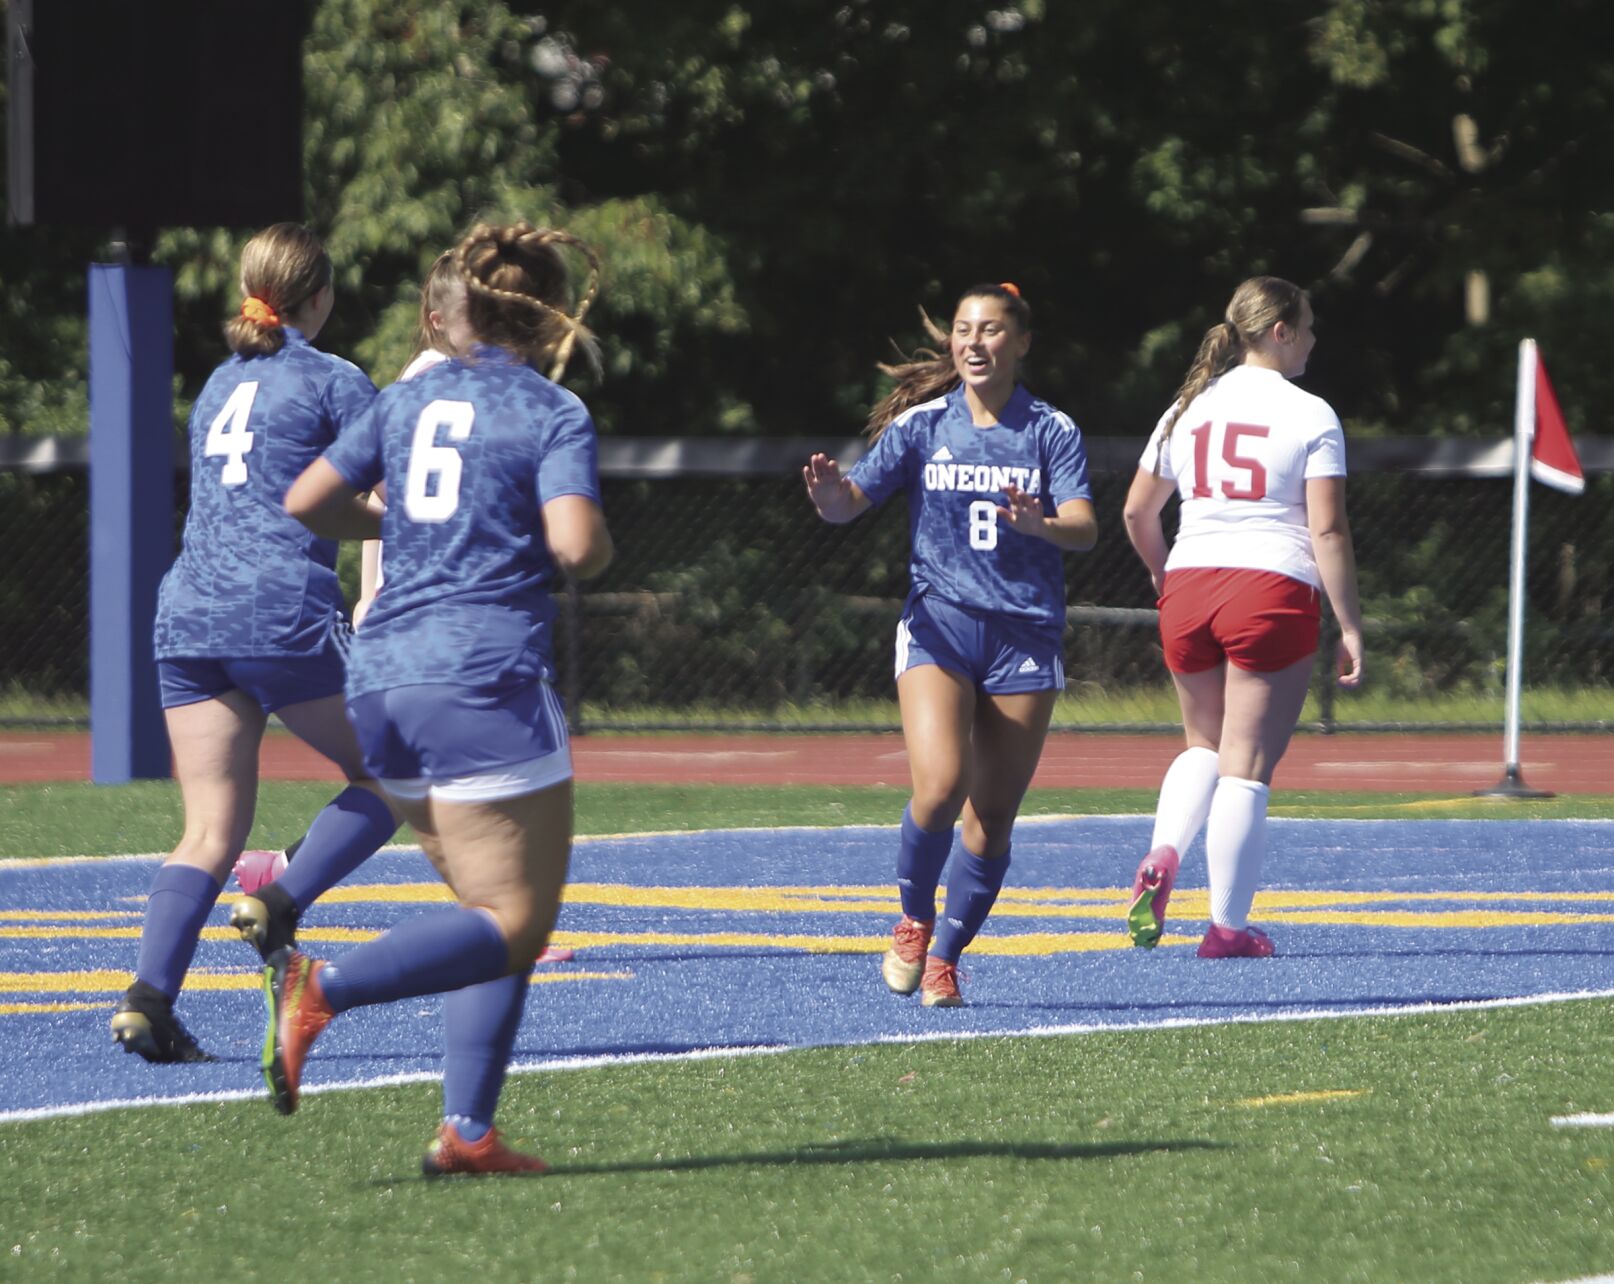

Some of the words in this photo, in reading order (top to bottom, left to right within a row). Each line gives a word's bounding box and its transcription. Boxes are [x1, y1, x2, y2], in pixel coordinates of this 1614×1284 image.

[205, 381, 259, 485] 4
[405, 400, 475, 523] 6
[1191, 421, 1270, 502] 15
[924, 463, 1041, 494] ONEONTA
[969, 501, 998, 551] 8
